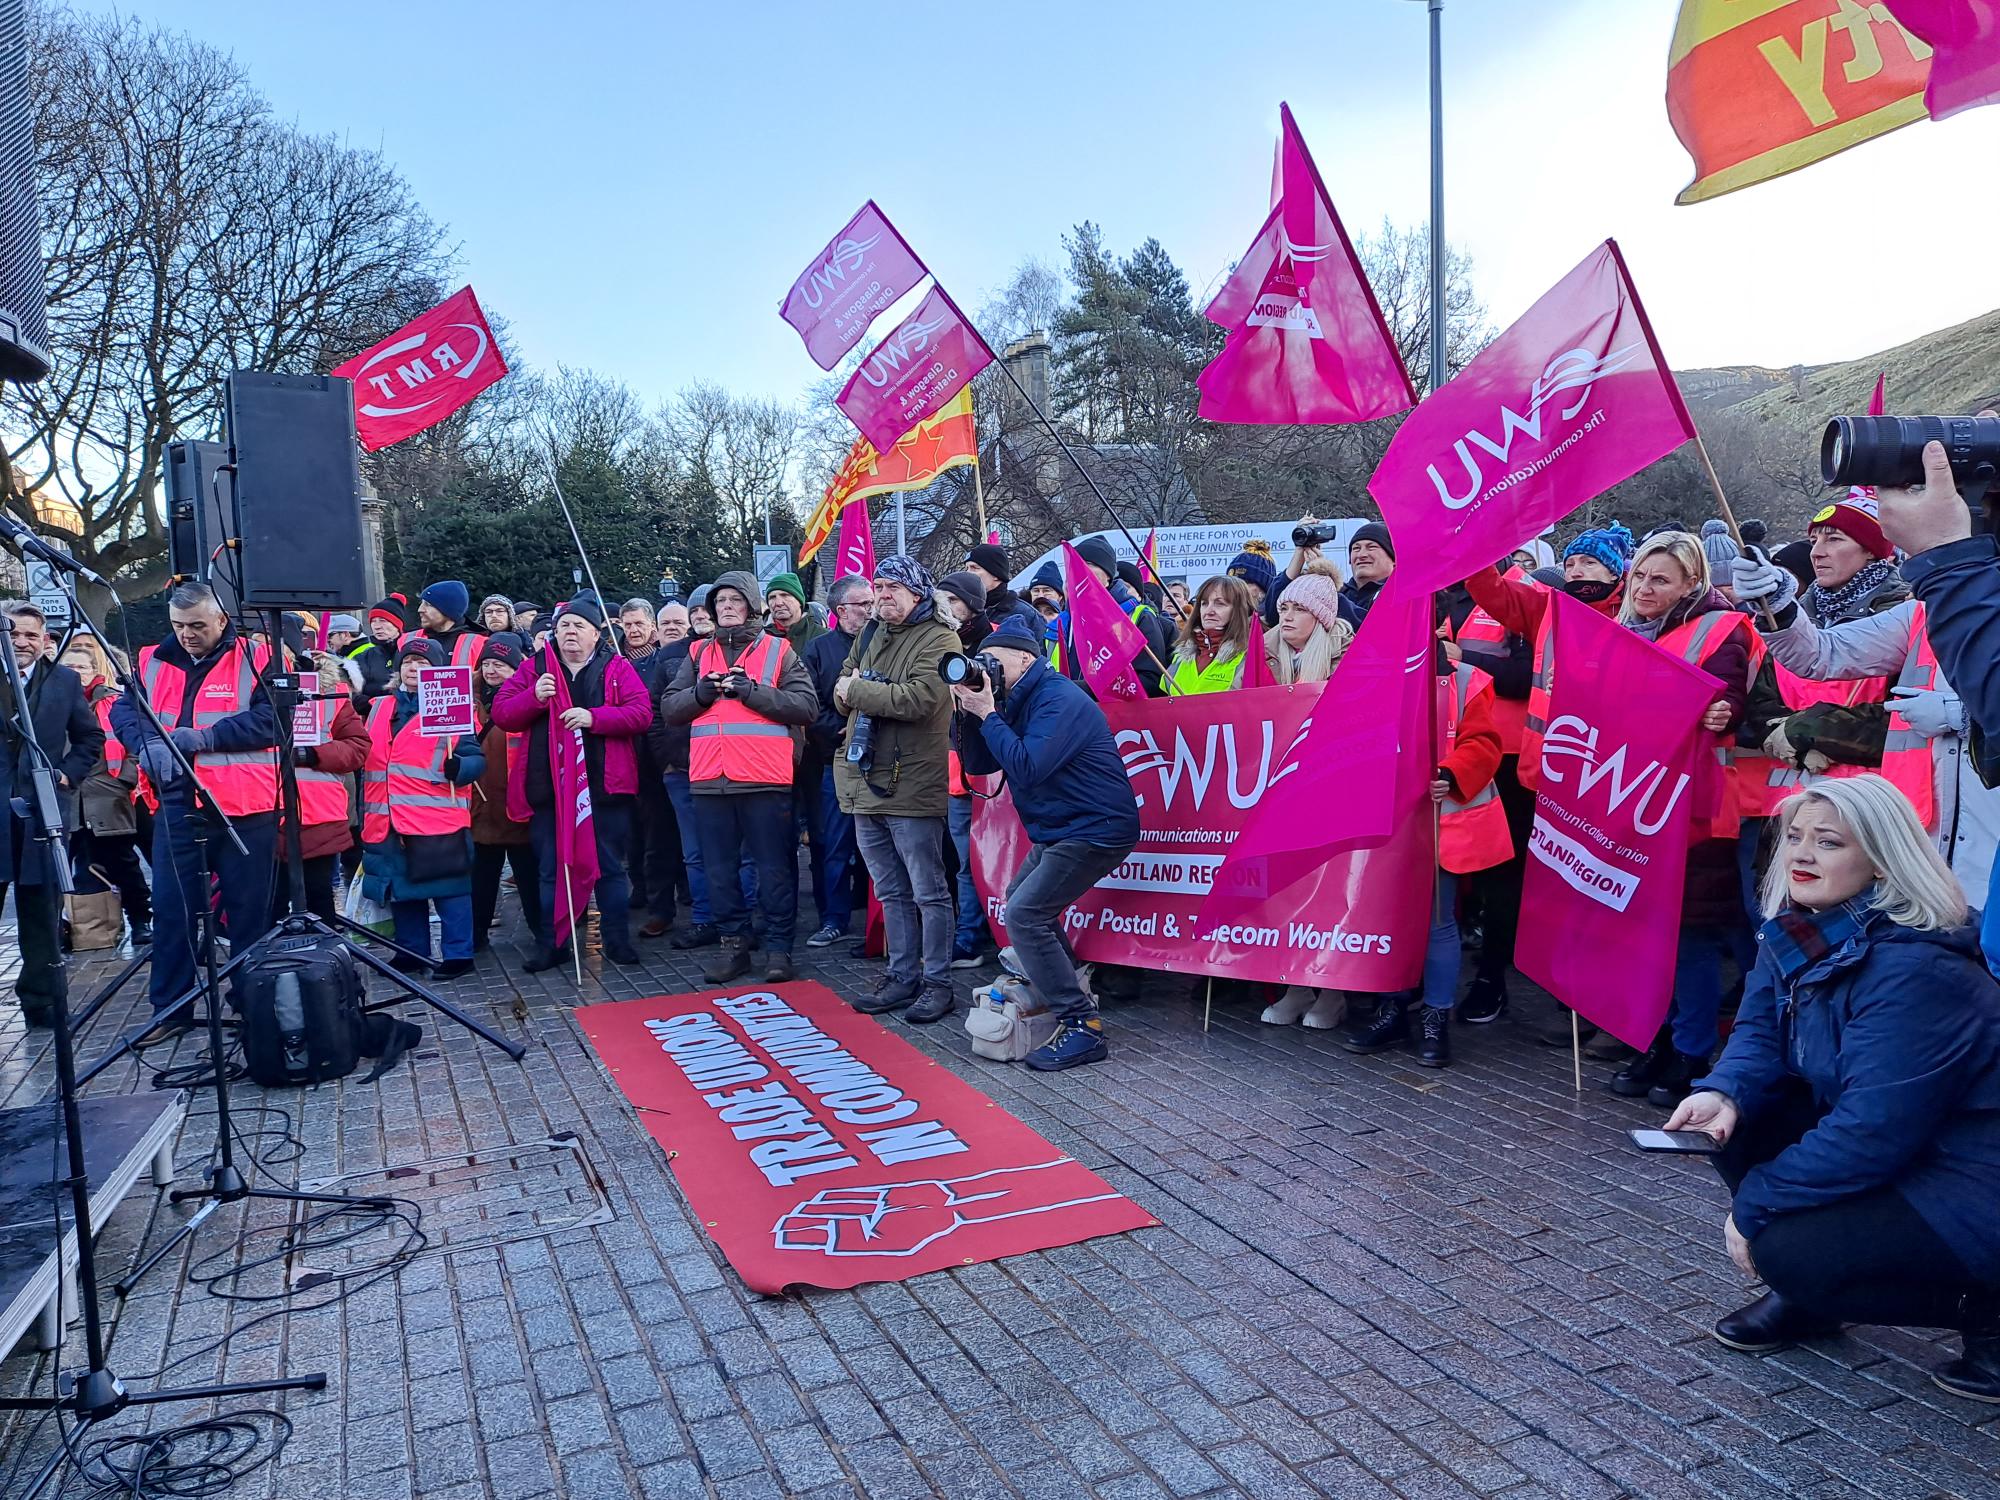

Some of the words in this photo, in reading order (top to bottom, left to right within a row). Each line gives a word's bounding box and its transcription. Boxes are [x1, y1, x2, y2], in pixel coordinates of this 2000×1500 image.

[1136, 533, 1176, 543] UNSON
[1179, 531, 1205, 541] HERE
[1208, 530, 1229, 540] FOR
[1179, 544, 1191, 553] AT
[1158, 560, 1179, 569] TEL:
[1181, 559, 1207, 567] 0800
[1211, 558, 1228, 566] 171
[42, 605, 65, 613] NDS
[423, 682, 439, 690] ON
[424, 688, 456, 698] STRIKE
[425, 698, 444, 707] FOR
[446, 695, 467, 705] FAIR
[426, 706, 445, 715] PAY
[1139, 827, 1222, 843] mmunications
[1615, 845, 1650, 866] union
[1105, 861, 1183, 884] COTLAND
[1063, 904, 1095, 933] for
[1098, 907, 1157, 936] Postal
[1163, 913, 1180, 939] &
[1287, 921, 1392, 954] Workers
[643, 1012, 770, 1090] UNIONS
[712, 991, 920, 1125] COMMUNITIES
[702, 1080, 859, 1187] TRADE
[855, 1119, 970, 1167] IN
